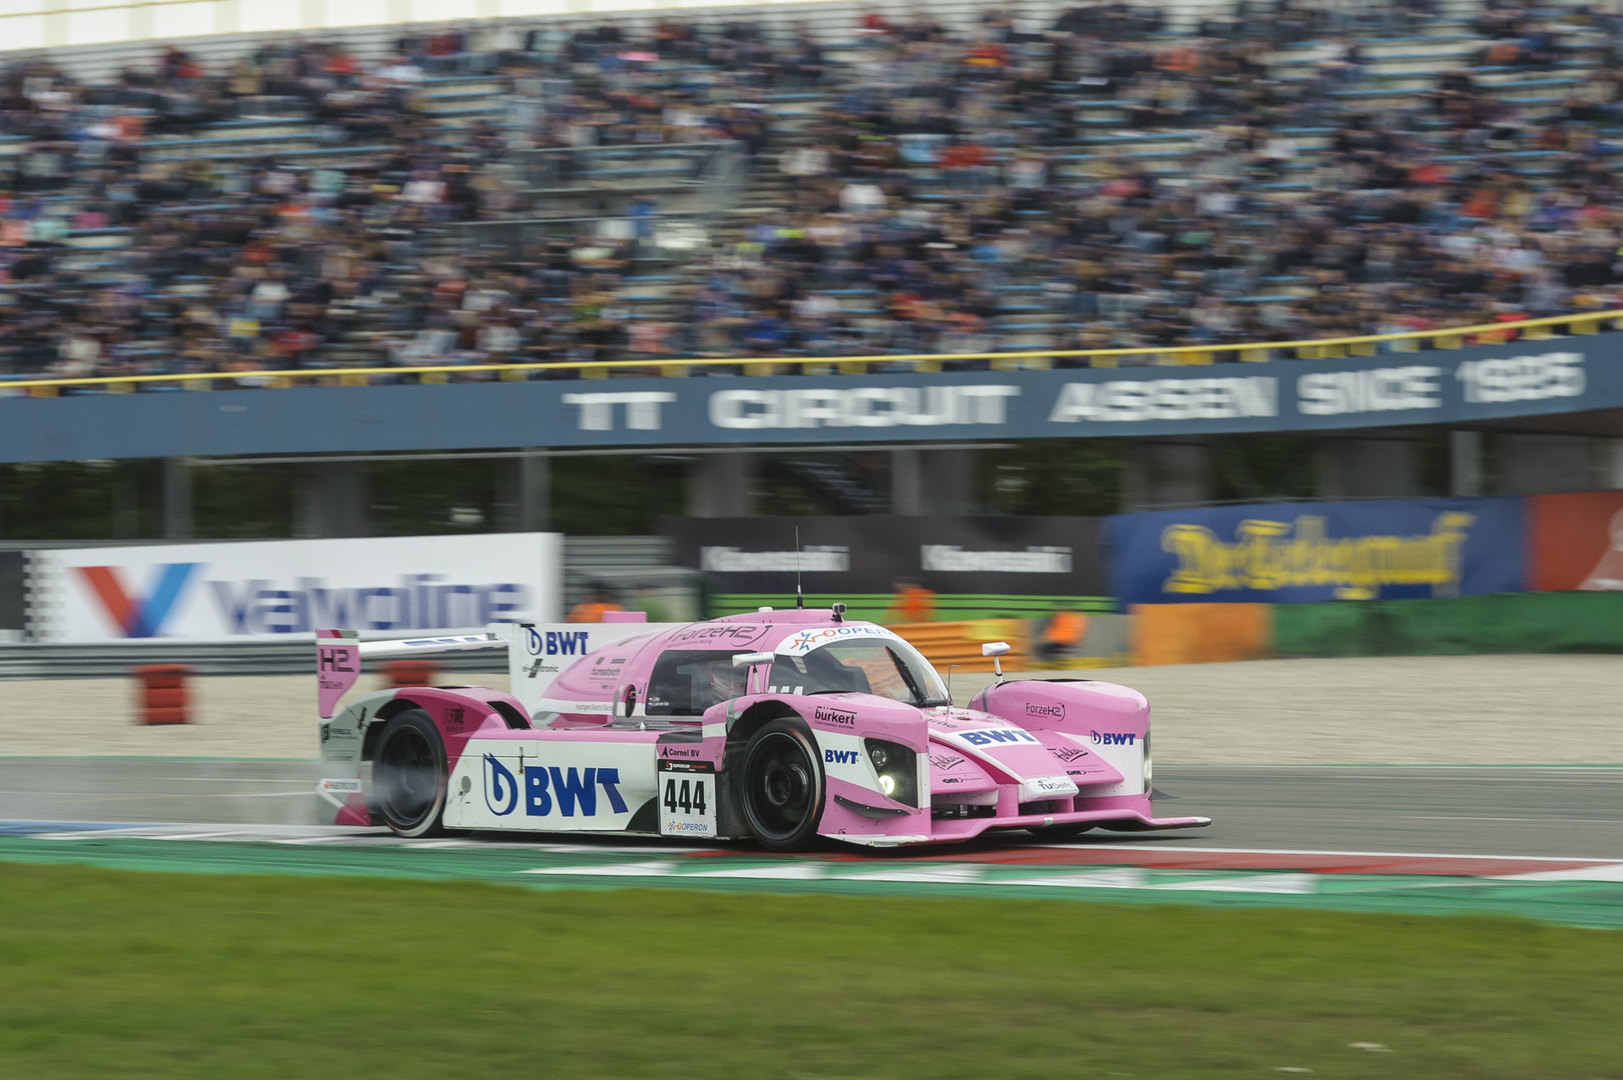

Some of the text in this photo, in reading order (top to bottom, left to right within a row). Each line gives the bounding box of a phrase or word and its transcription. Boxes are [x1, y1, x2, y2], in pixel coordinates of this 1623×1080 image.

[562, 391, 678, 430] TT
[708, 385, 1022, 429] CIRCUIT
[1049, 376, 1279, 422] ASSEN
[1297, 366, 1442, 416] SINCE
[206, 573, 536, 634] Valvoline
[545, 631, 589, 656] BWT
[320, 648, 355, 673] H2
[959, 729, 1036, 746] BWT
[1103, 732, 1136, 746] BWT
[668, 748, 700, 757] Cornel BV
[825, 749, 859, 765] BWT
[525, 766, 629, 817] BWT
[664, 778, 706, 815] 444
